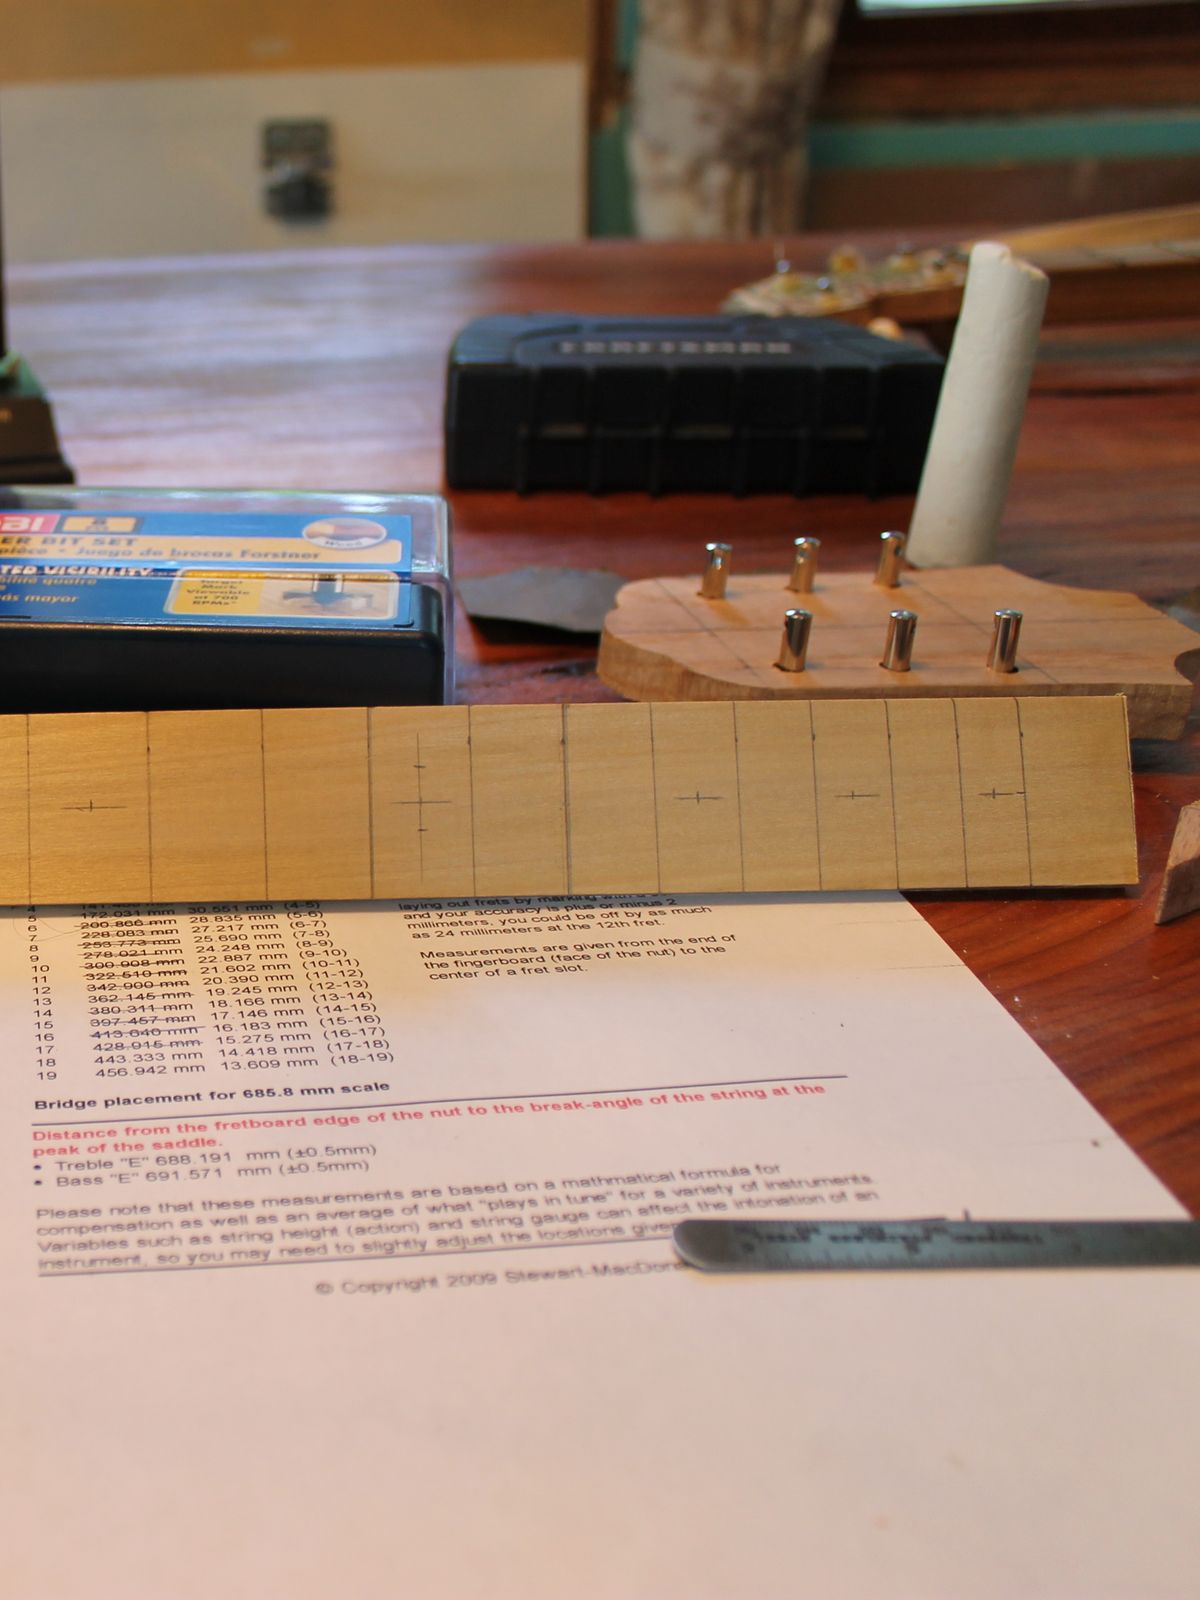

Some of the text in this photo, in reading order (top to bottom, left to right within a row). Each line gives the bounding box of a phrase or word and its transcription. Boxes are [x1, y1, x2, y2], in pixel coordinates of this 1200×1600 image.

[42, 537, 82, 545] BIT
[93, 538, 136, 546] SET
[139, 548, 163, 556] de
[240, 549, 321, 559] Forstner
[42, 577, 96, 585] quatre
[25, 595, 77, 603] mayor
[434, 930, 455, 938] 24
[460, 926, 542, 937] millimeters
[547, 924, 561, 932] at
[566, 923, 591, 931] the
[596, 921, 630, 929] 12th
[633, 919, 665, 927] fret.
[420, 946, 538, 959] Measurements
[542, 944, 568, 952] are
[573, 941, 615, 952] given
[618, 940, 655, 948] from
[721, 934, 736, 942] of
[424, 945, 726, 970] the fingerboard (face of the nut) to the
[429, 971, 479, 981] center
[485, 969, 500, 977] of
[521, 966, 550, 975] fret
[554, 964, 587, 974] slot.
[33, 991, 373, 1018] 14 380.311 mm 18.166 mm (13-14)
[34, 1021, 54, 1030] 15
[165, 1015, 196, 1023] mm
[211, 1009, 268, 1021] 17.146
[274, 1008, 304, 1017] mm
[316, 1003, 377, 1015] (14-15)
[35, 1033, 54, 1042] 16
[167, 1027, 198, 1035] mm
[213, 1022, 271, 1033] 16.183
[277, 1020, 308, 1029] mm
[319, 1015, 381, 1028] (15-16)
[36, 1045, 54, 1054] 17
[169, 1039, 201, 1048] mm
[216, 1033, 274, 1045] 15.275
[280, 1032, 312, 1041] mm
[323, 1027, 386, 1040] (16-17)
[36, 1040, 390, 1067] 18 443.333 mm 14.418 mm (17-18)
[36, 1052, 394, 1081] 19 456.942 mm 13.609 mm (18-19)
[34, 1082, 390, 1111] Bridge placement for 685.8 mm scale
[32, 1084, 826, 1142] Distance from the fretboard edge of the nut to the break-angle of the string at the
[32, 1138, 223, 1158] peak of the saddle.
[55, 1144, 377, 1171] Treble "E" 688.191 mm (±0.5mm)
[56, 1160, 370, 1188] Bass "E" 691.571 mm (±0.5mm)
[36, 1163, 782, 1220] Please note that these measurements are based on a mathmatical formula for
[340, 1271, 498, 1296] Copyright 2009
